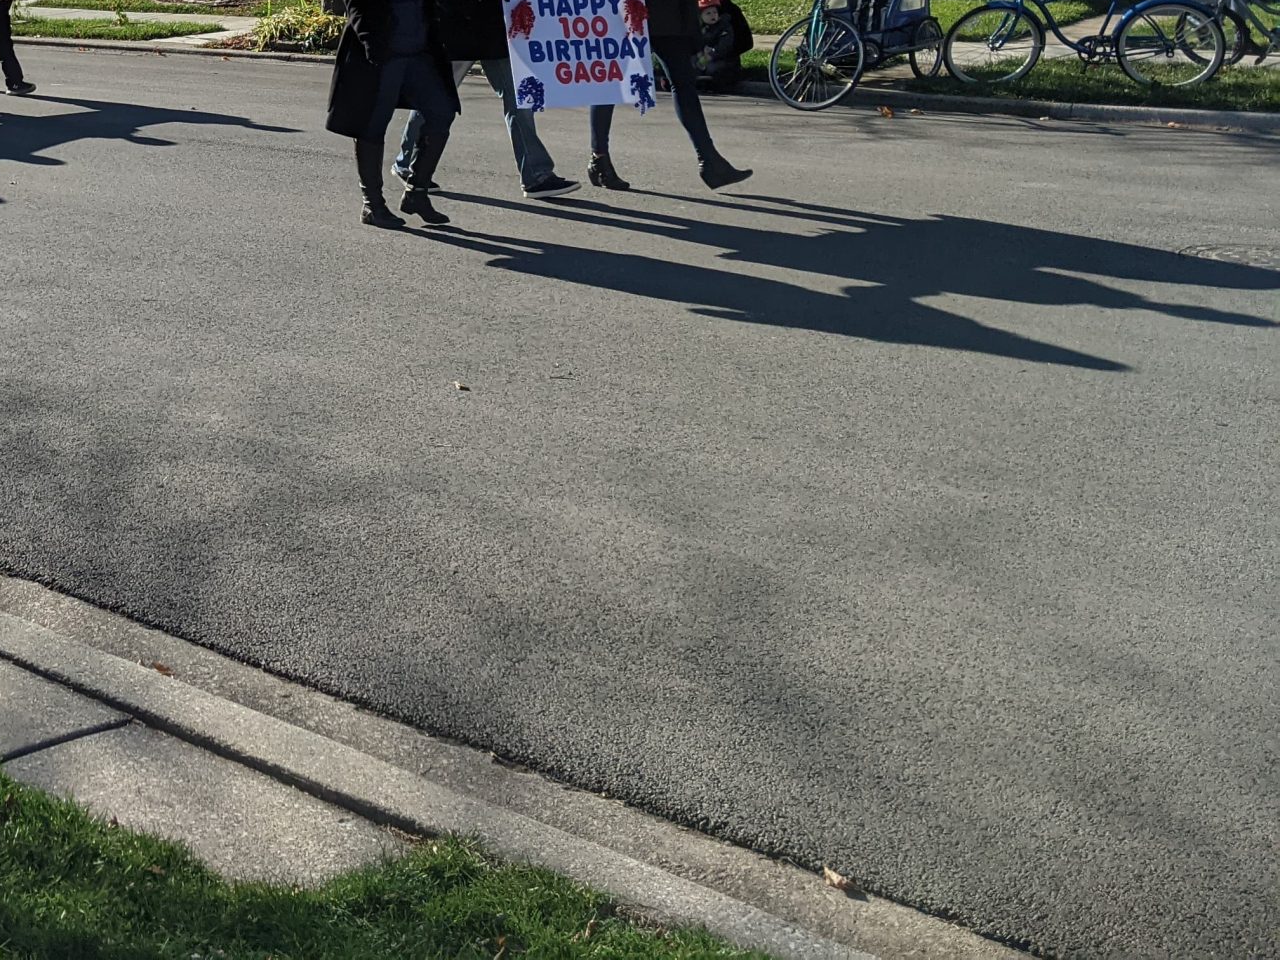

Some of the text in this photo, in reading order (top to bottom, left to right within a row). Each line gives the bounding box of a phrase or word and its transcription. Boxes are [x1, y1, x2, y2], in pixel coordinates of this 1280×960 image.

[559, 16, 608, 39] 100
[528, 36, 648, 63] BIRTHDAY
[555, 60, 624, 85] GAGA
